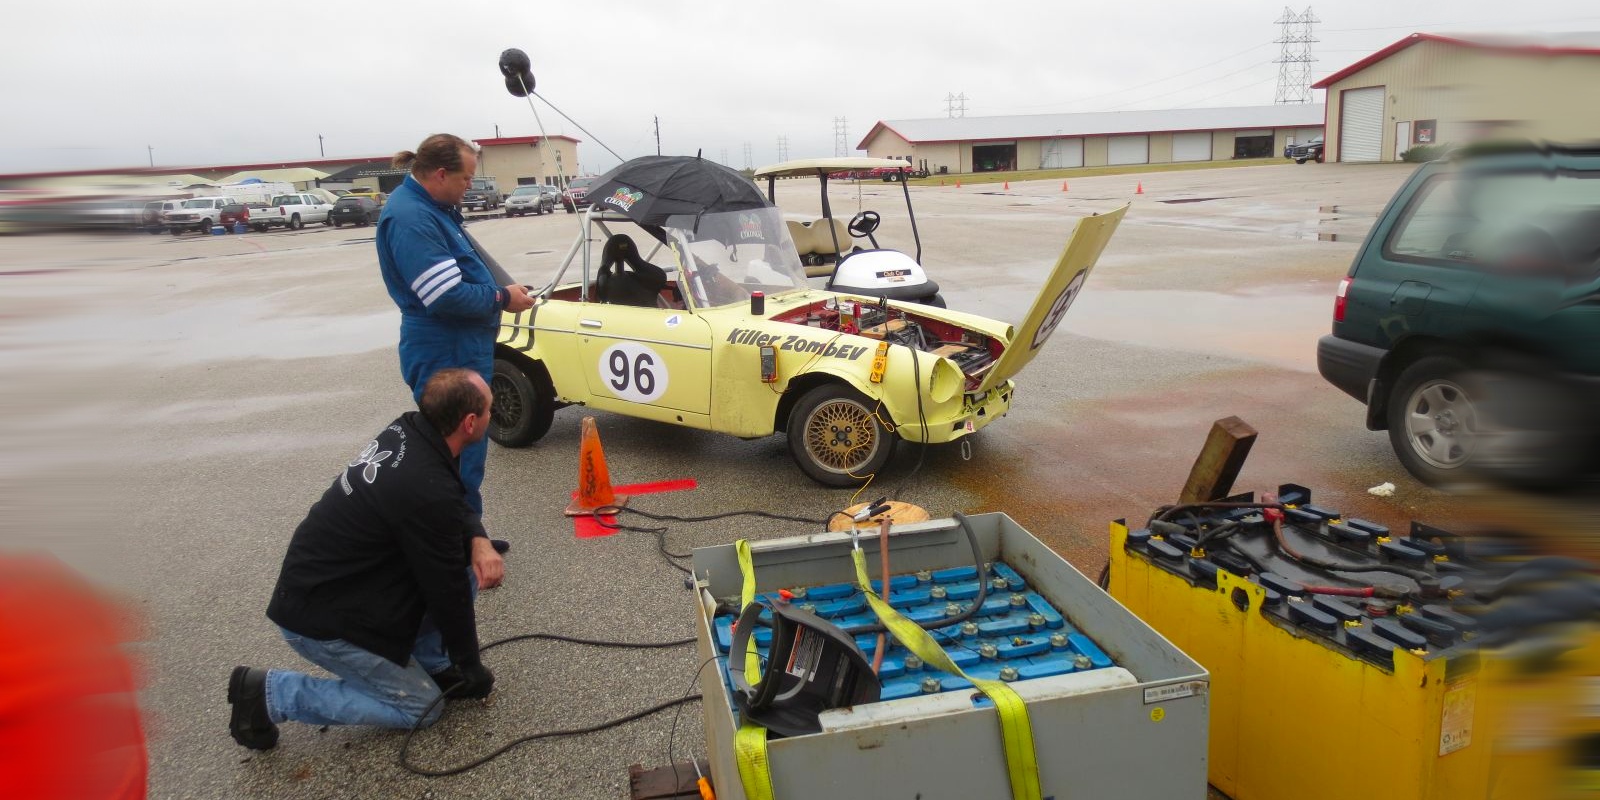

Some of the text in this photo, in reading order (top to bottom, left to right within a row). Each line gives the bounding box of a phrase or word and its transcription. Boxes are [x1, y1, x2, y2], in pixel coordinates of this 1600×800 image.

[726, 328, 868, 361] Killer ZombEV
[609, 349, 656, 396] 96
